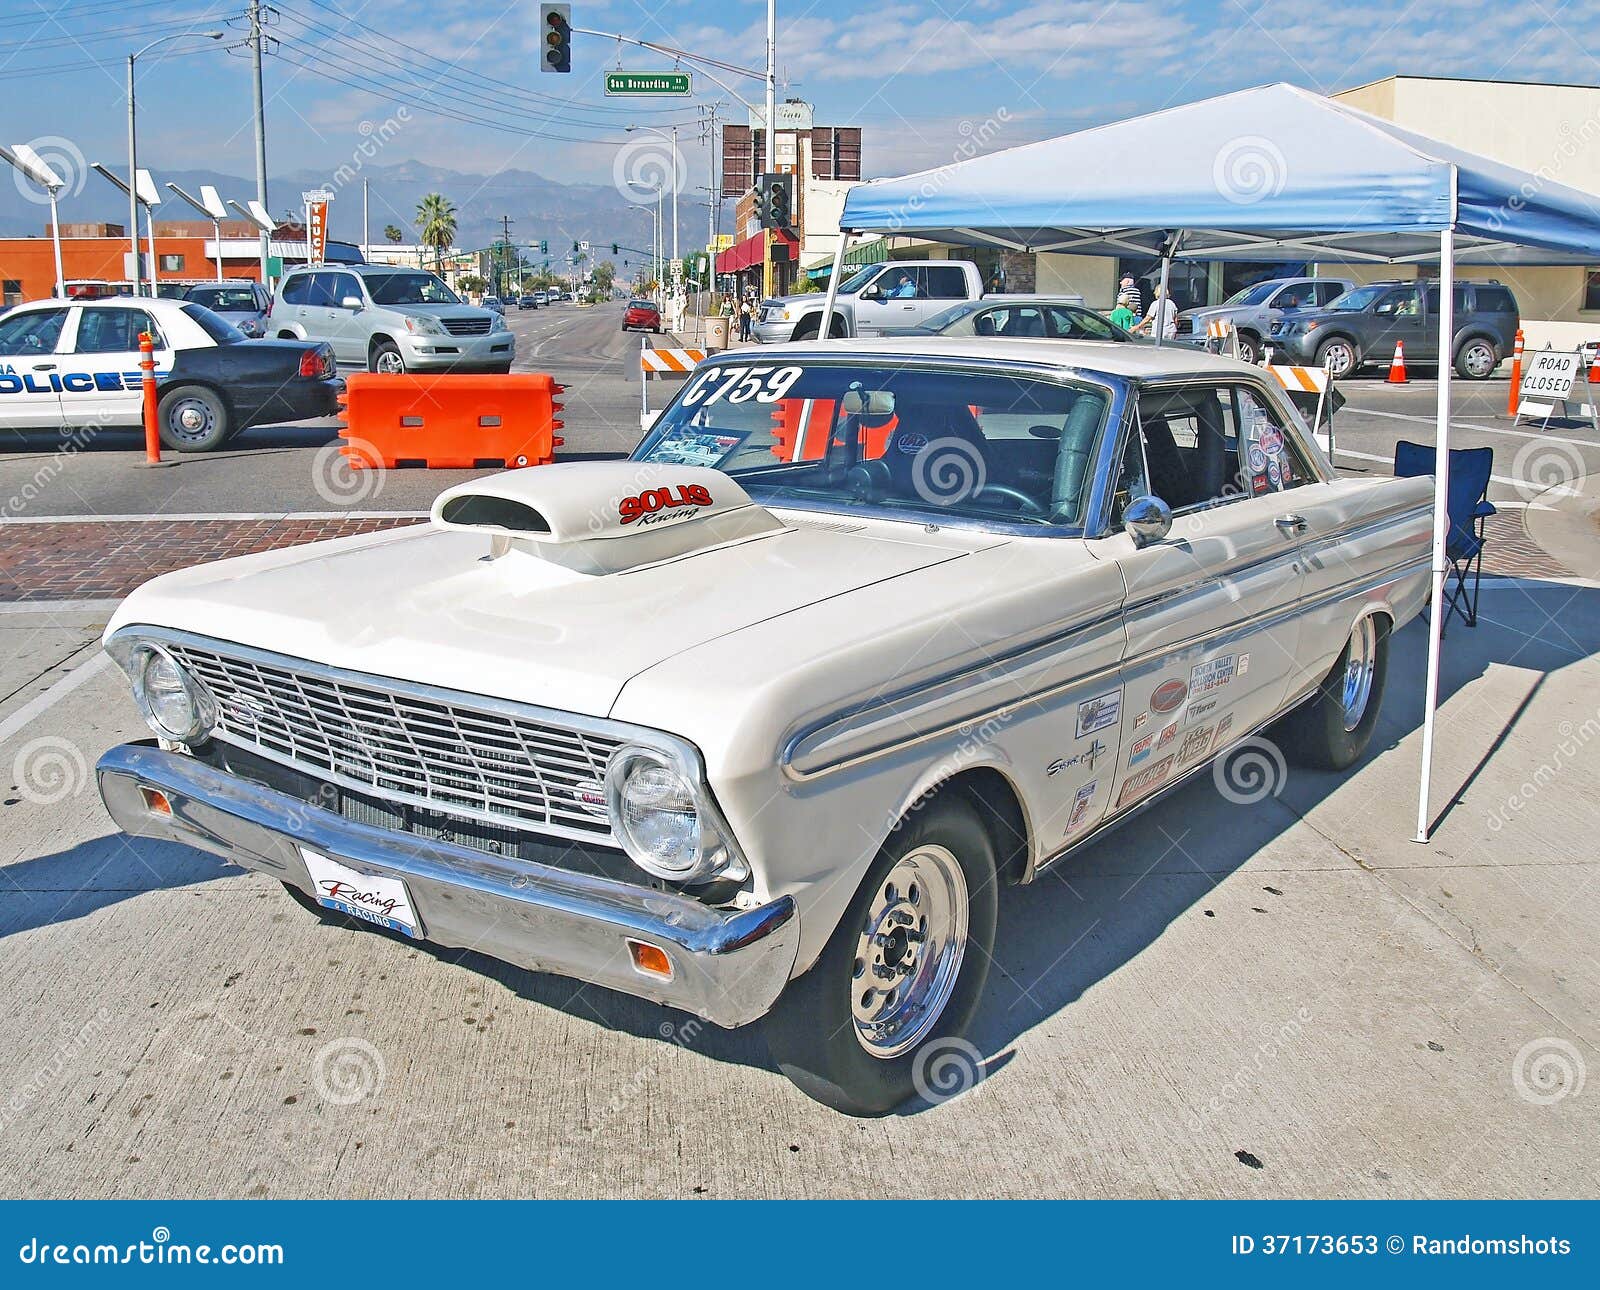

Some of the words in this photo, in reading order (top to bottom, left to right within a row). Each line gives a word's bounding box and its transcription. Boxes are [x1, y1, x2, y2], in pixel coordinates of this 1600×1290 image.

[610, 78, 624, 89] San
[628, 78, 670, 89] Bernardino
[842, 264, 863, 272] SOUP
[1538, 357, 1570, 371] ROAD
[681, 366, 804, 407] C759
[1524, 376, 1571, 392] CLOSED
[619, 484, 713, 525] SOLIS
[637, 507, 700, 527] Racing
[1214, 655, 1233, 670] VALLEY
[1216, 666, 1234, 680] CENTER
[319, 880, 405, 915] Racing
[346, 905, 391, 928] RACING
